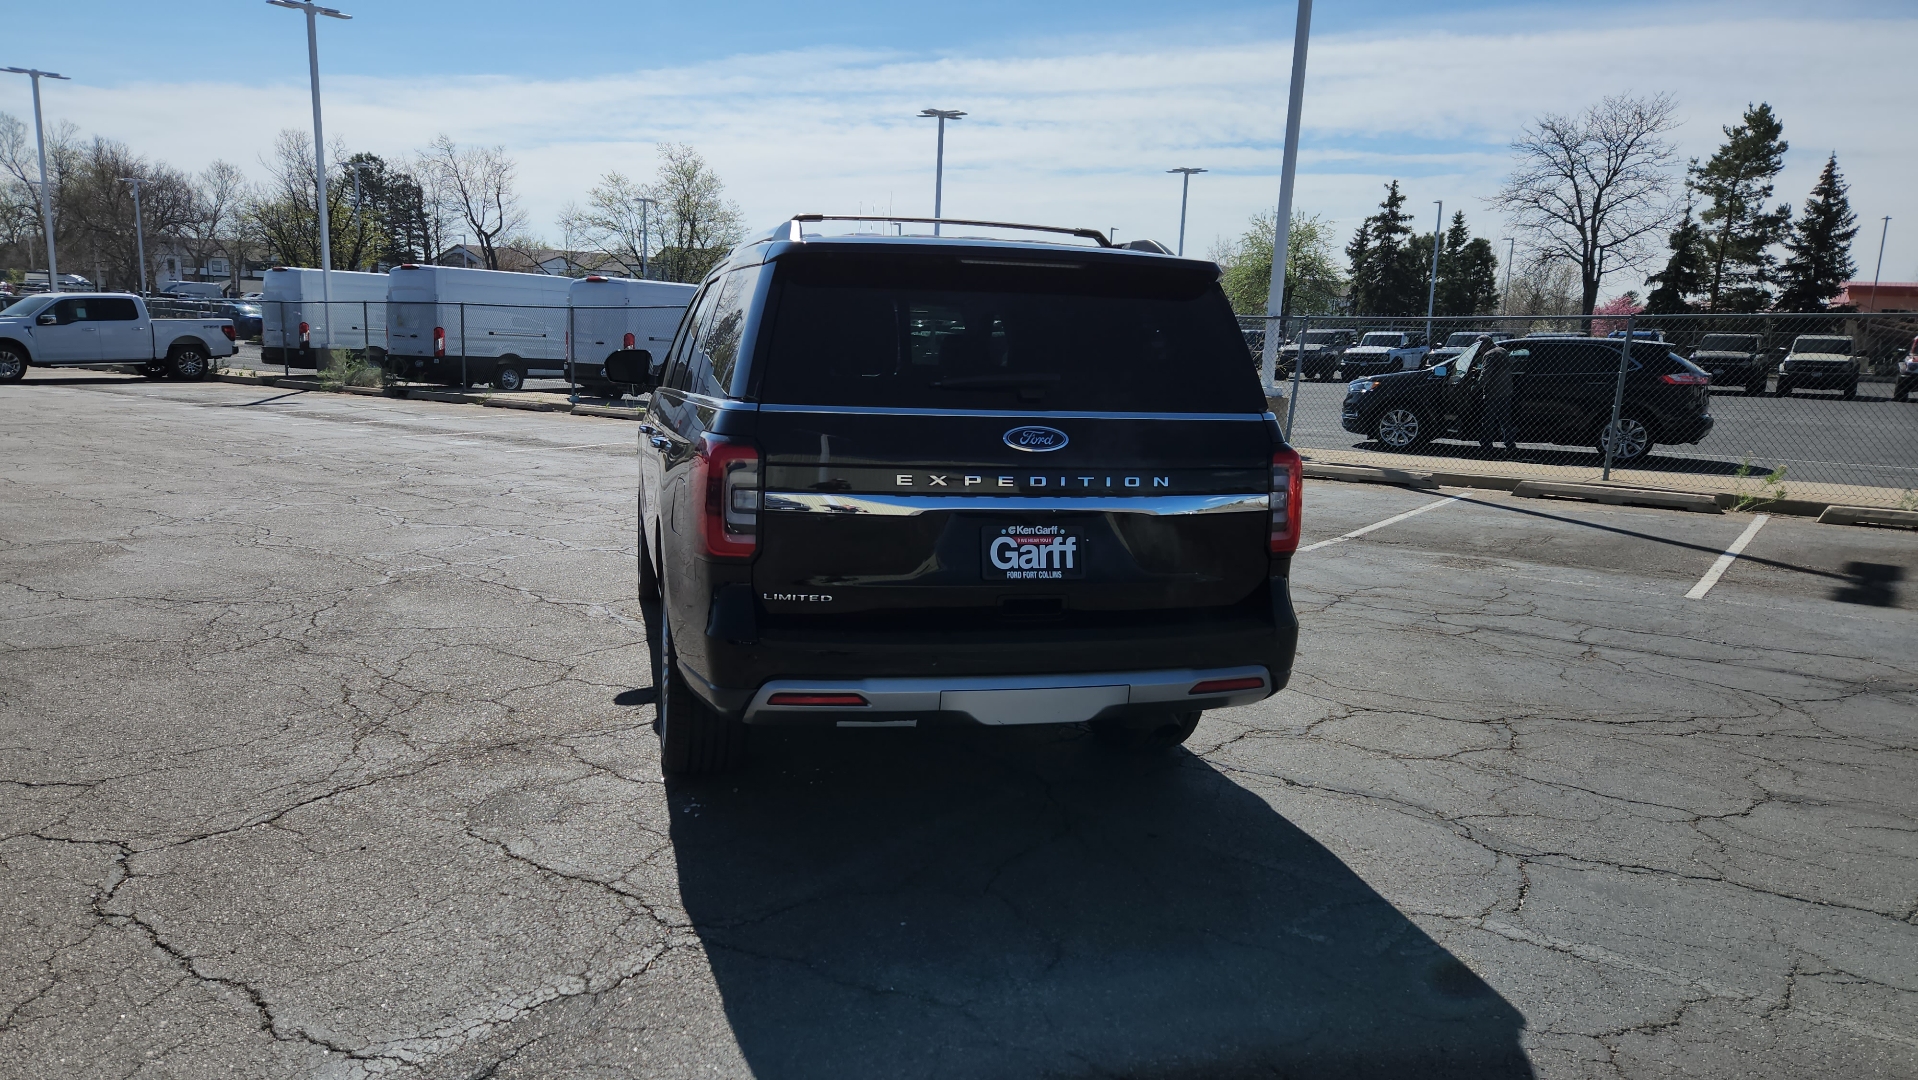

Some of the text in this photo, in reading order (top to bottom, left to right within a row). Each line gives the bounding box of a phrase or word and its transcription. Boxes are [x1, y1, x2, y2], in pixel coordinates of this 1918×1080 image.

[1019, 430, 1054, 445] Ford
[896, 474, 1170, 487] EXPEDITION
[1016, 525, 1058, 535] Ken Garff
[990, 536, 1077, 570] Garff
[1006, 570, 1062, 579] FORD FORT COLLINS
[763, 592, 833, 602] LIMITED
